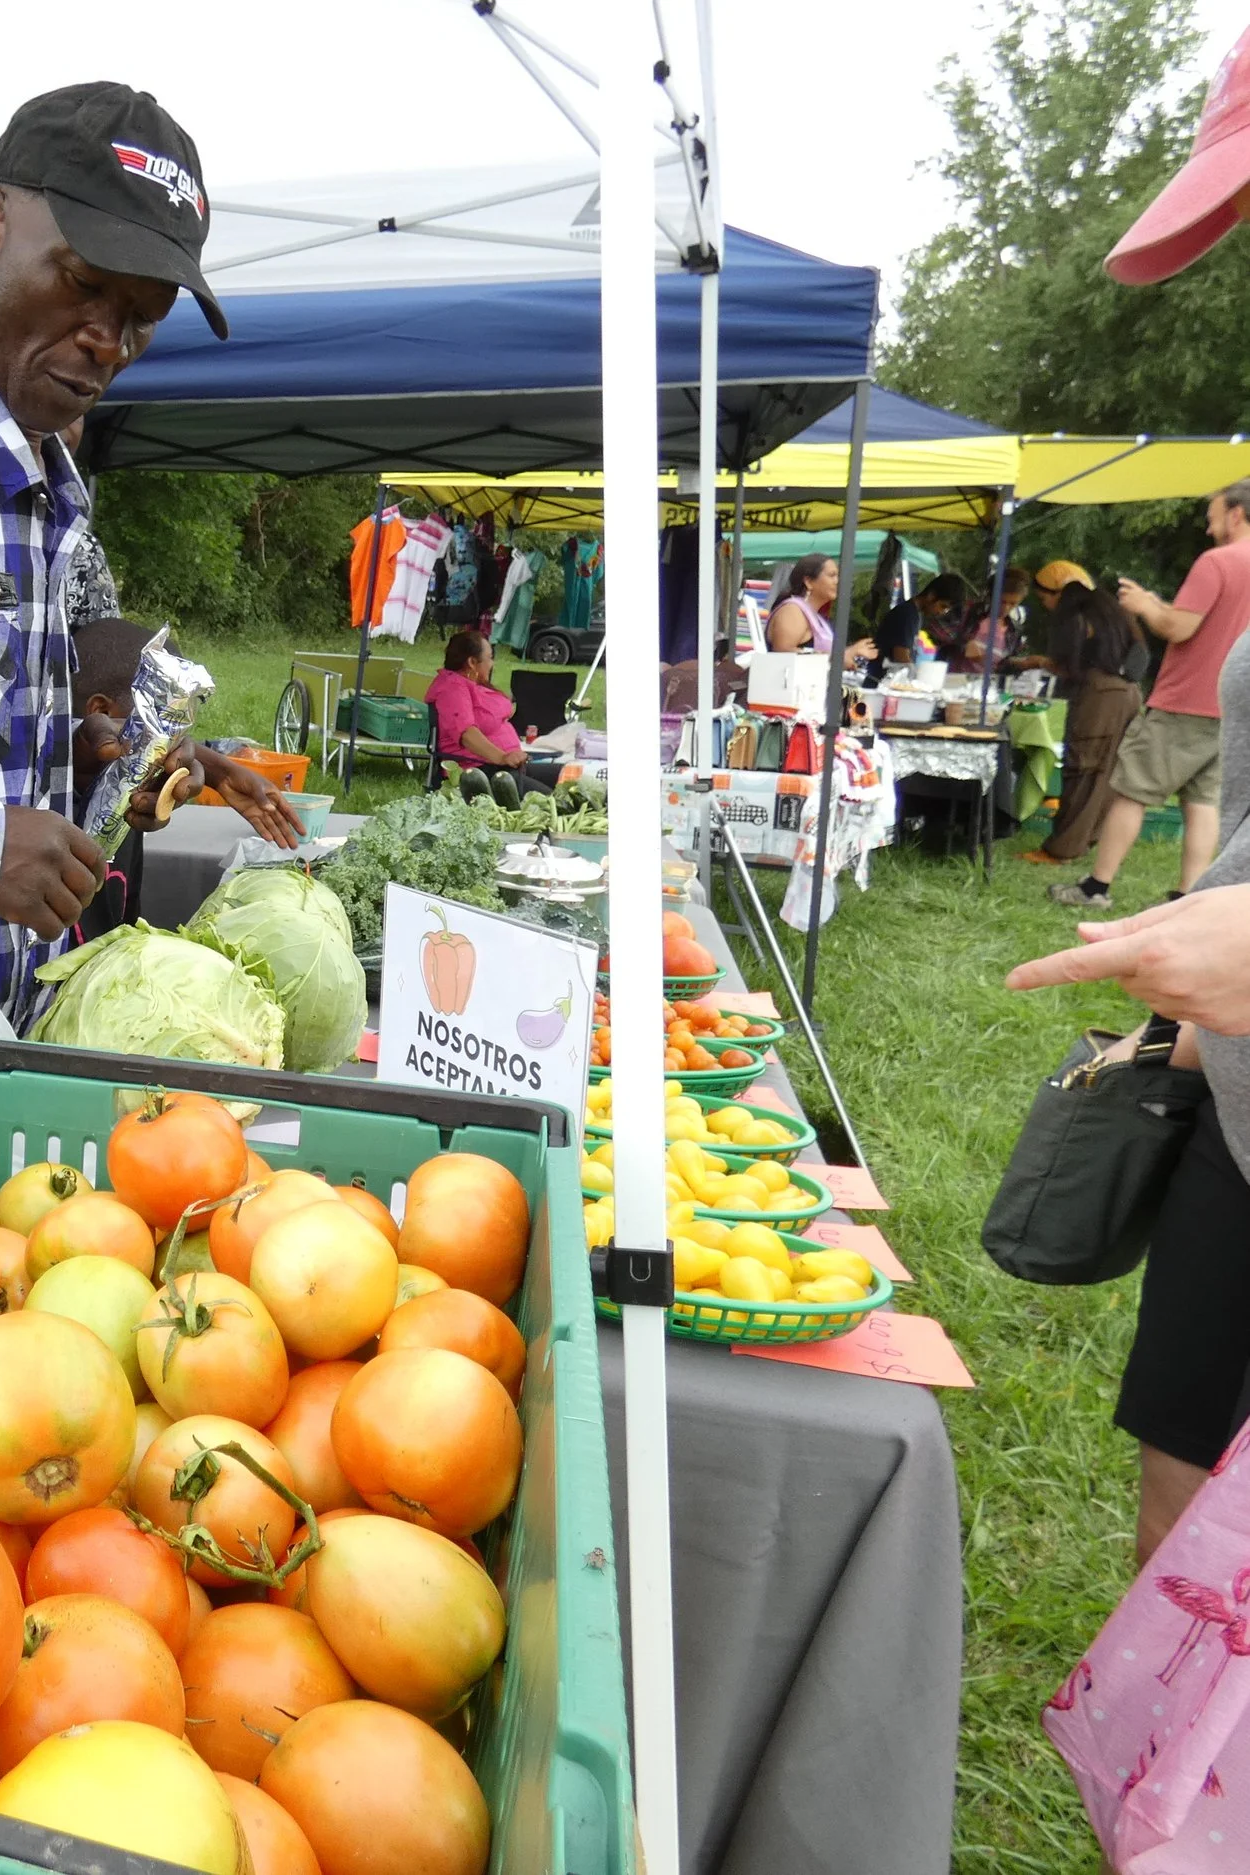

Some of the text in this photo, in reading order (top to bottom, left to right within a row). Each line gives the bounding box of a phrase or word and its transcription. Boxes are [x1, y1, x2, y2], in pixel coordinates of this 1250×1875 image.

[145, 155, 179, 182] TOP
[406, 1044, 521, 1096] ACEPTA
[418, 1011, 542, 1090] NOSOTROS
[857, 1319, 936, 1380] $6.00
